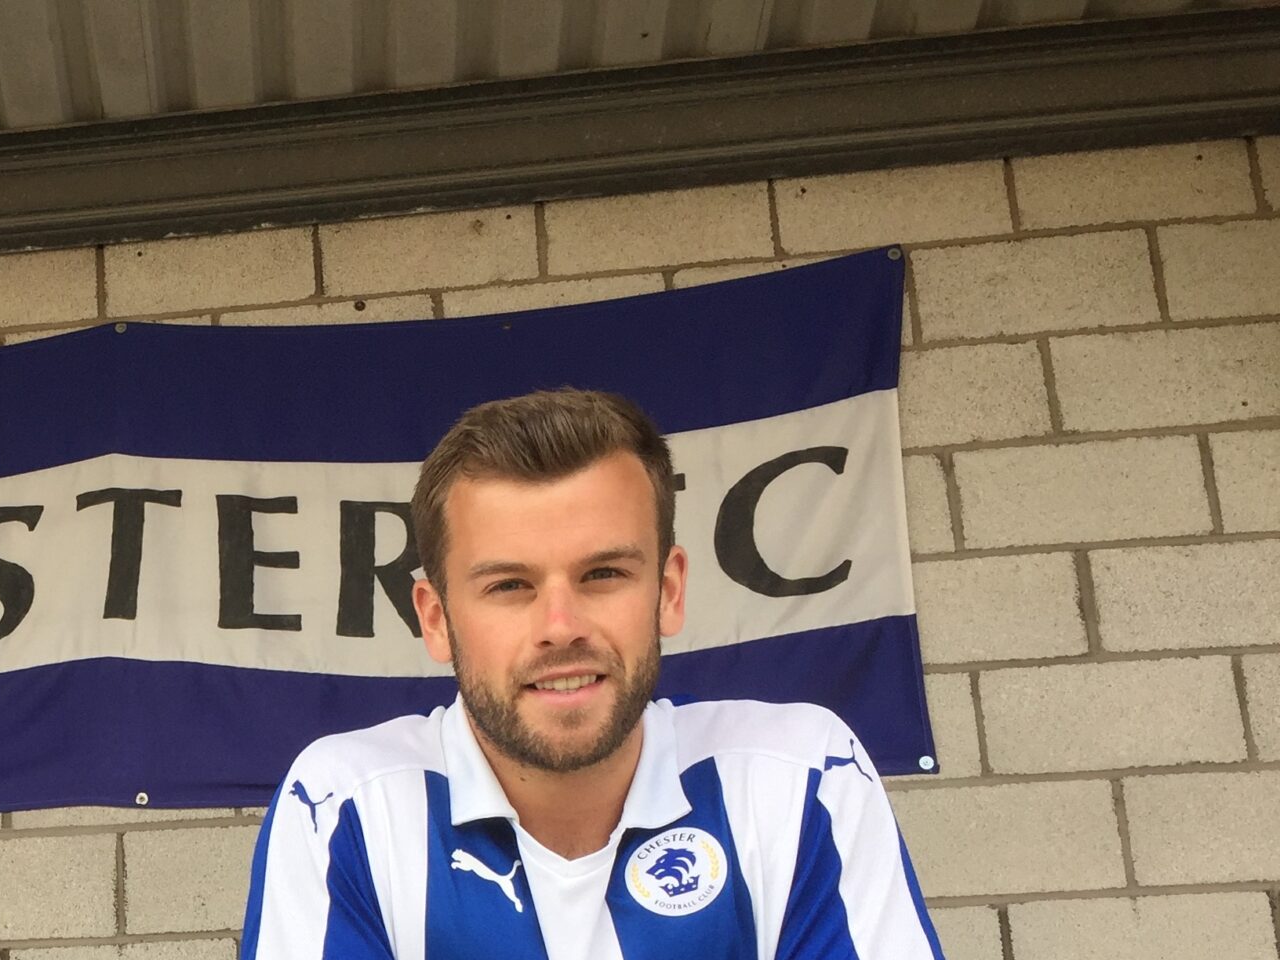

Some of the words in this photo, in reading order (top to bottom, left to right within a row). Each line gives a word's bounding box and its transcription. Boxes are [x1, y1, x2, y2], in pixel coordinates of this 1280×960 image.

[673, 446, 853, 598] C
[637, 832, 696, 860] CHESTER
[654, 899, 697, 910] FOOTBALL
[698, 884, 715, 902] CLUB
